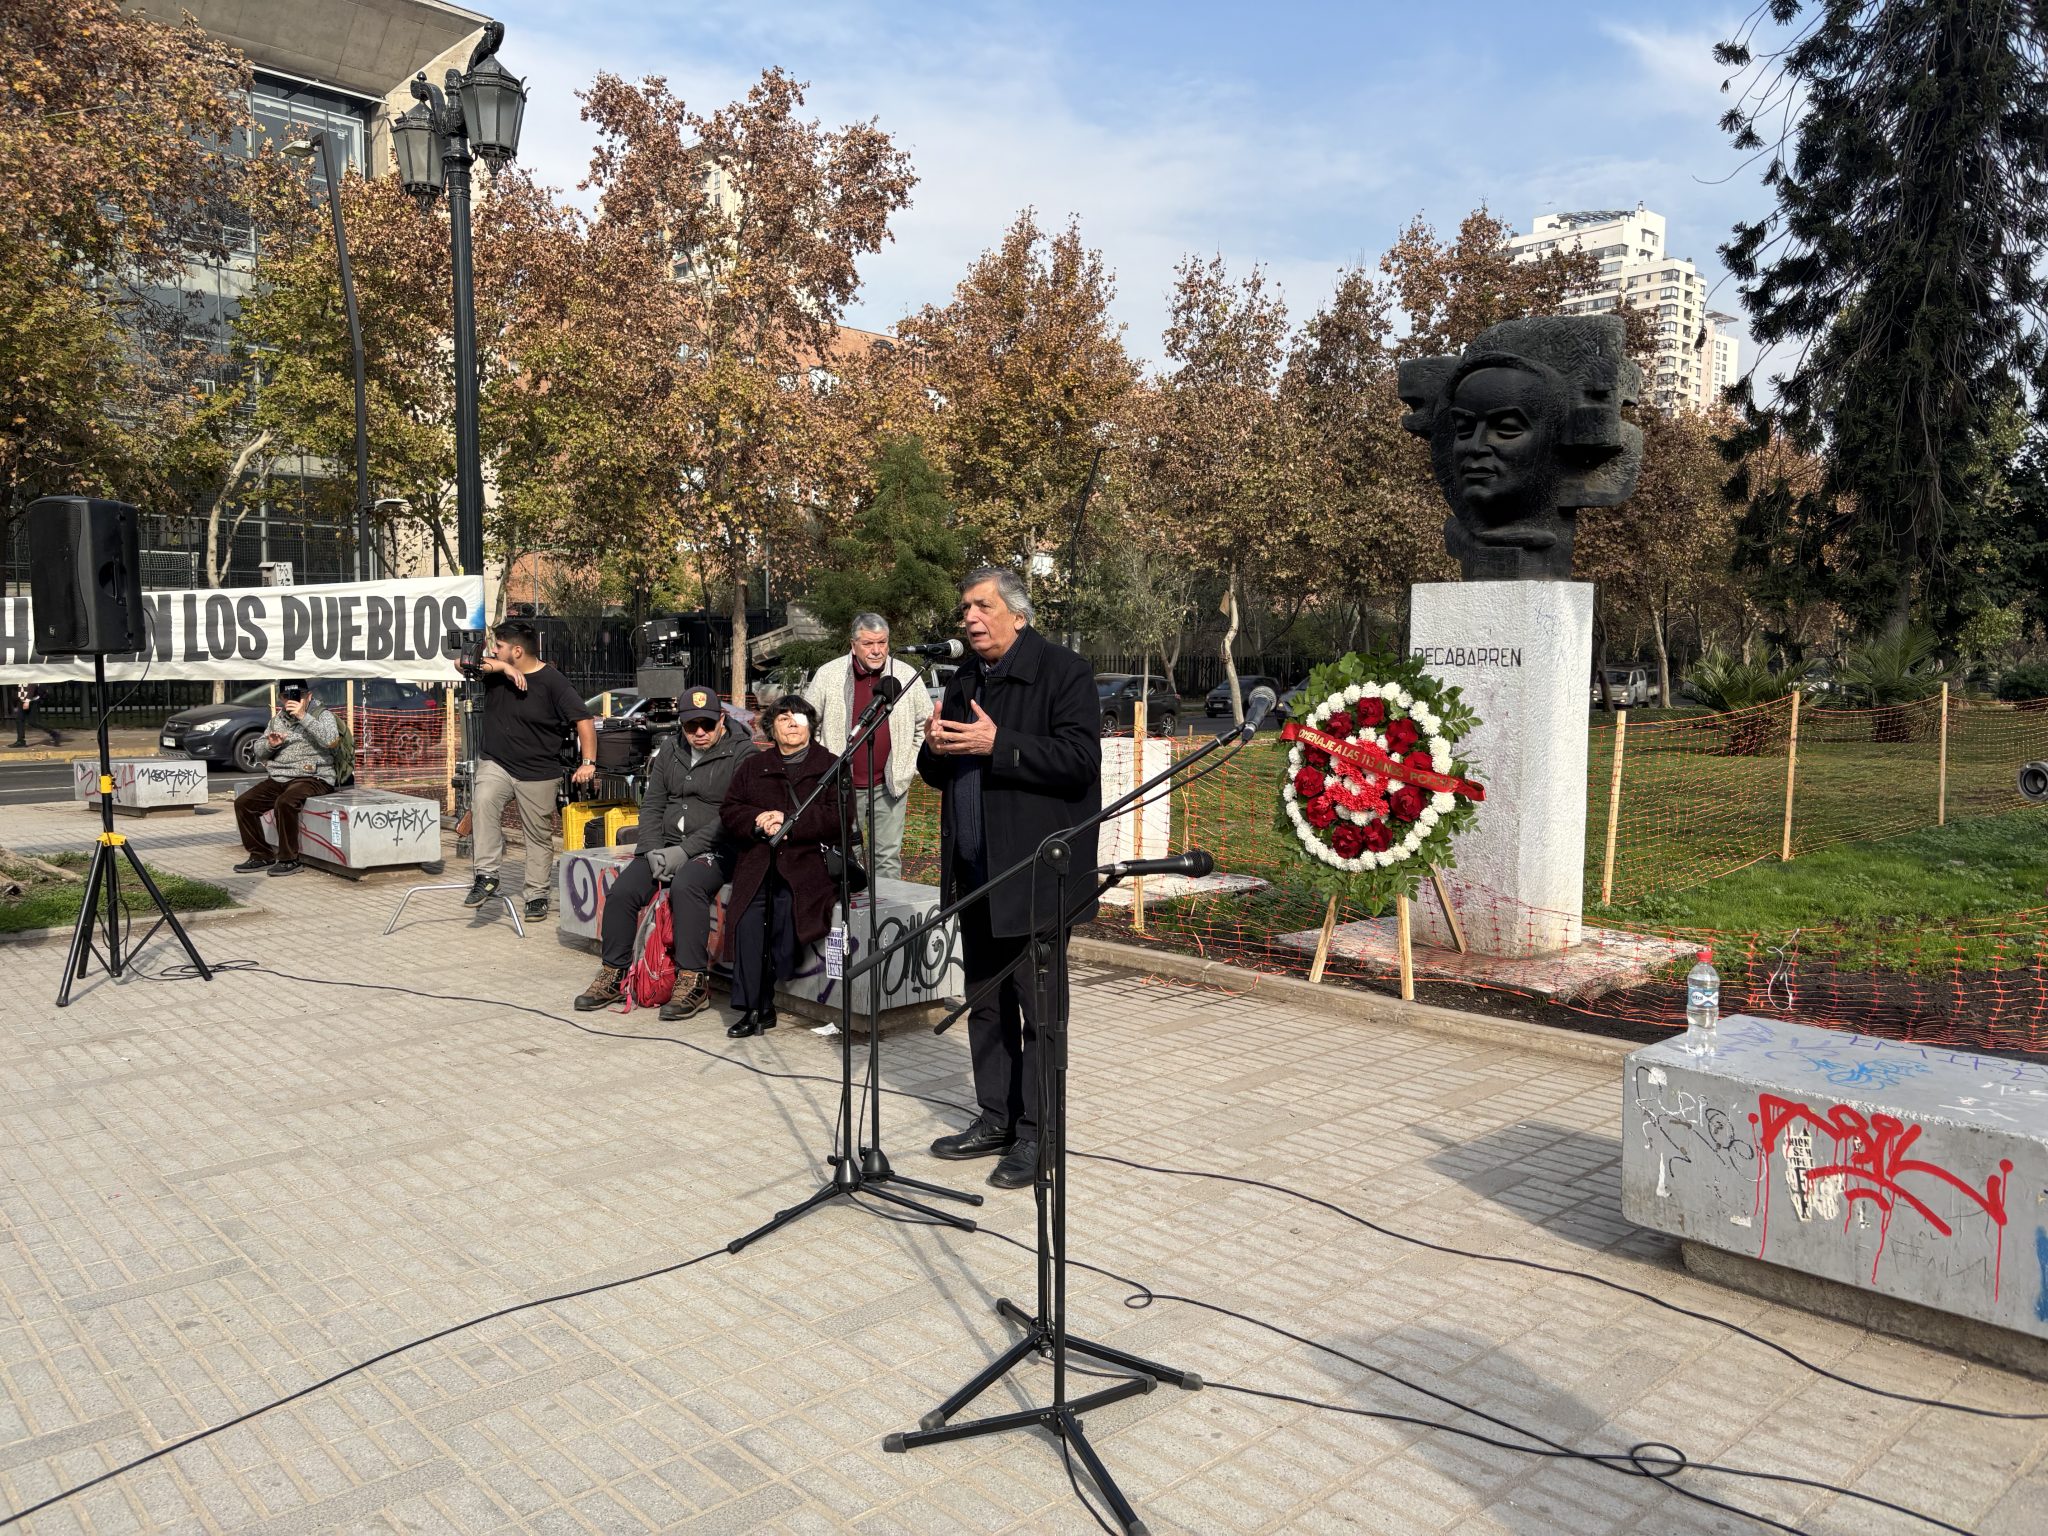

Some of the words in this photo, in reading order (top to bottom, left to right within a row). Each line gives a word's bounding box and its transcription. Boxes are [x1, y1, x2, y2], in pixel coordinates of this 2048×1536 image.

[183, 593, 267, 662] LOS
[281, 595, 467, 661] PUEBLOS
[1298, 729, 1336, 751] OMENAJE
[1341, 747, 1360, 761] LAS
